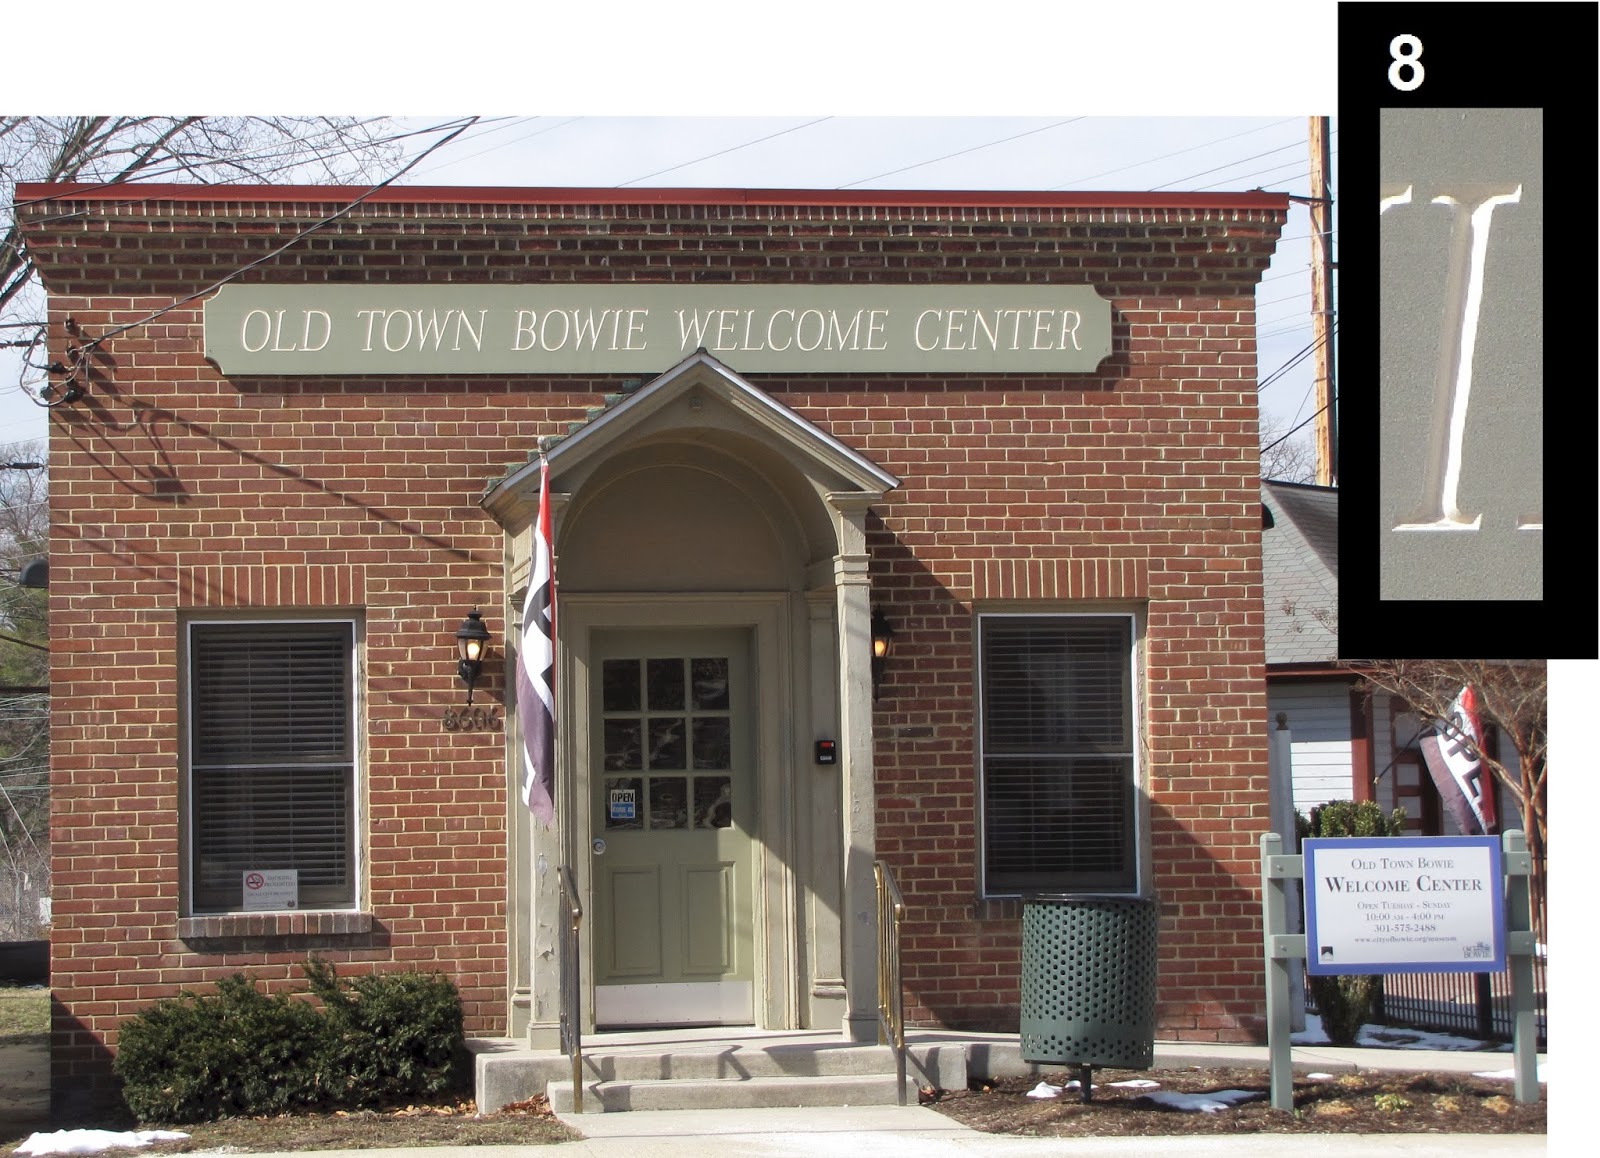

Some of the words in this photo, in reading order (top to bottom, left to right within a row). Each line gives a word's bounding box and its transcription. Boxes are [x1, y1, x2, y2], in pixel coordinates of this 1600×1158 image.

[241, 309, 333, 352] OLD
[357, 308, 488, 352] TOWN
[510, 308, 649, 352] BOWIE
[674, 308, 889, 352] WELCOME
[914, 308, 1083, 352] CENTER
[443, 707, 501, 732] 8606
[612, 793, 634, 803] OPEN
[1351, 858, 1376, 870] OLD
[1380, 857, 1414, 870] TOWN
[1418, 857, 1454, 869] BOWIE
[1325, 876, 1410, 893] WELCOME
[1416, 874, 1483, 892] CENTER
[1357, 901, 1378, 910] OPEN
[1381, 901, 1414, 909] TUESDAY
[1422, 901, 1451, 909] SUNDAY
[1366, 913, 1390, 921] 10:00
[1412, 912, 1432, 921] 4:00
[1374, 923, 1437, 933] 301-575-2488
[1354, 935, 1457, 943] www.cityofbowie.org/museum
